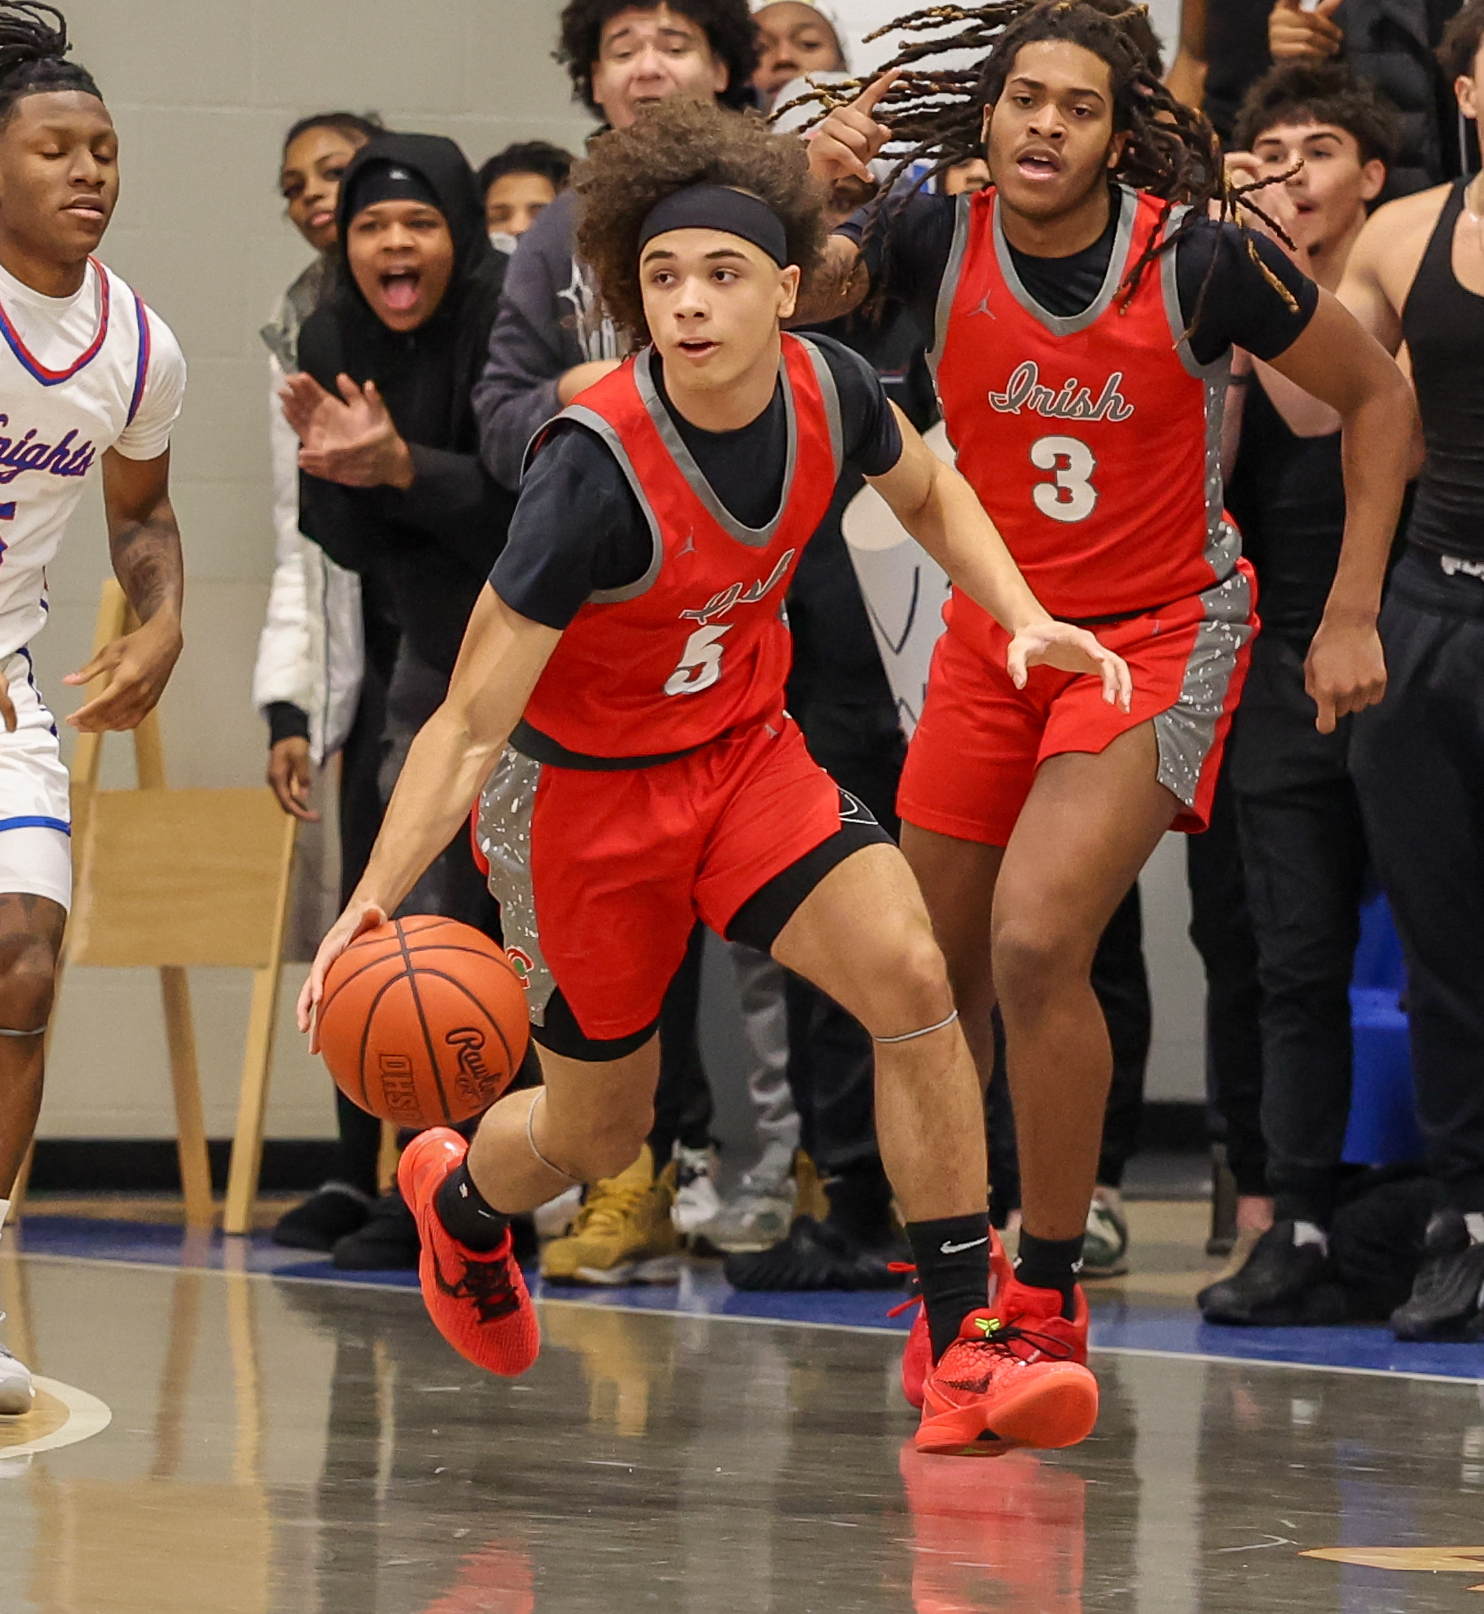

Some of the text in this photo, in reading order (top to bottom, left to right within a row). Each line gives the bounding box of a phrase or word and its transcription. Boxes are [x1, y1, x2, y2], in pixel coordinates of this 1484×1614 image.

[988, 360, 1135, 423] Irish
[1029, 434, 1099, 524] 3
[663, 622, 736, 697] 5
